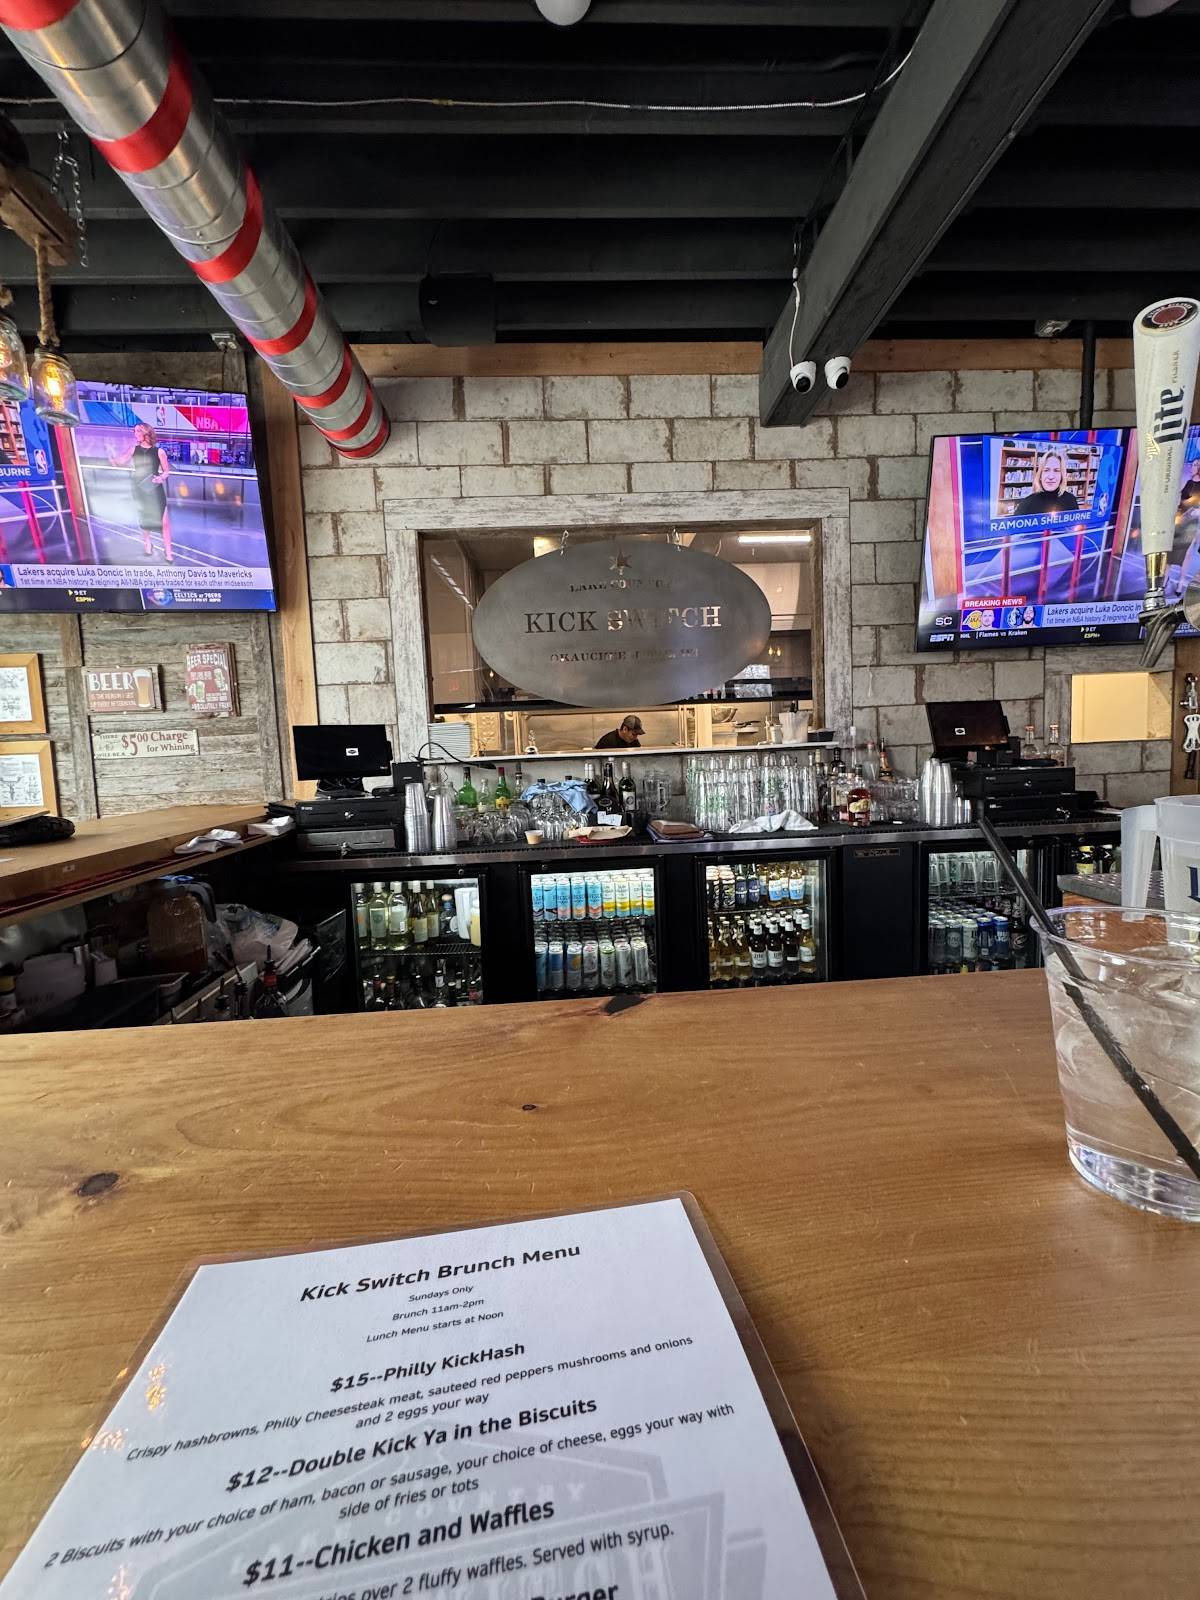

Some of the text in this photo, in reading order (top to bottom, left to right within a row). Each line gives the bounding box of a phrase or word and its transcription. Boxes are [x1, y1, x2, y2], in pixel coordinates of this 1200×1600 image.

[1153, 388, 1187, 443] Lite
[990, 511, 1092, 532] RAMONA SHELBURNE
[18, 568, 253, 580] Lakers acquire Luka Doncic in trade, Anthony Davis to Mavericks
[67, 579, 88, 587] history
[95, 580, 119, 588] reigning
[144, 580, 165, 588] players
[964, 598, 1023, 608] BREAKING NEWS
[1047, 607, 1069, 616] Lakers
[1070, 606, 1094, 615] acquire
[1095, 604, 1111, 613] Luka
[1111, 604, 1134, 612] Doncic
[524, 610, 599, 634] KICK
[935, 616, 953, 626] SC
[930, 633, 954, 642] ESPN
[88, 671, 135, 691] BEER
[150, 731, 188, 744] Charge
[160, 743, 195, 752] Whining
[300, 1244, 581, 1302] Kick Switch Brunch Menu
[408, 1285, 474, 1303] Sundays Only
[392, 1299, 485, 1321] Brunch 11am-2pm
[366, 1311, 504, 1343] Lunch Menu starts at Noon
[330, 1342, 526, 1393] $15--Philly KickHash
[126, 1336, 693, 1462] Crispy hashbrowns, Philly Cheesesteak meat, sauteed red peppers mushrooms and onions
[355, 1391, 490, 1429] and 2 eggs your way
[225, 1397, 598, 1493] $12--Double Kick Ya in the Biscuits
[44, 1402, 735, 1569] 2 Biscuits with your choice of ham, bacon or sausage, your choice of cheese, eggs your way with
[338, 1477, 480, 1520] side of fries or tots
[242, 1530, 411, 1587] $11--Chicken
[418, 1515, 463, 1547] and
[470, 1498, 556, 1536] Waffles
[361, 1582, 398, 1600] over
[403, 1576, 414, 1595] 2
[419, 1562, 462, 1591] fluffy
[466, 1554, 528, 1581] waffles.
[532, 1540, 585, 1566] Served
[590, 1532, 622, 1553] with
[627, 1521, 675, 1547] syrup.
